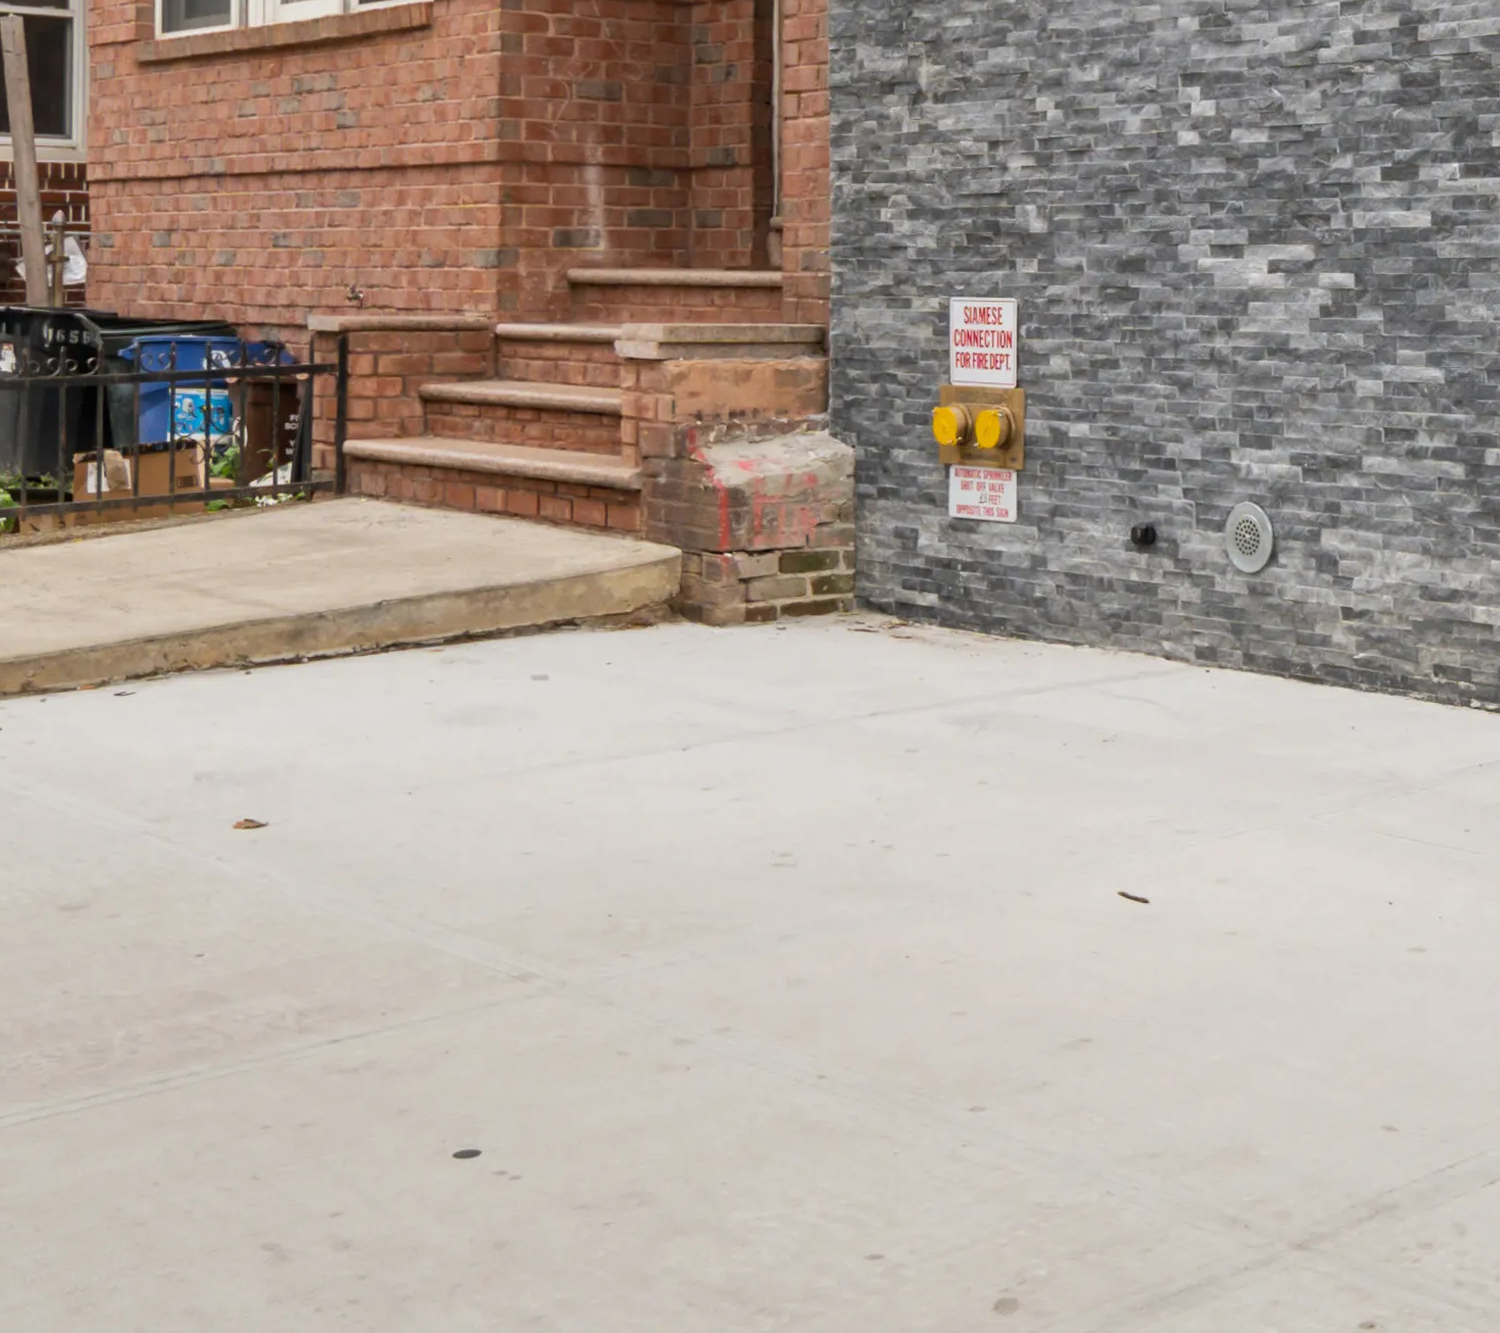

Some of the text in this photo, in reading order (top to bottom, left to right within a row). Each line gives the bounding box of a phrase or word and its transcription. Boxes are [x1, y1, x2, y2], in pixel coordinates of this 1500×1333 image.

[963, 306, 1003, 325] SIAMESE
[954, 329, 1013, 348] CONNECTION
[955, 352, 1012, 370] FOR FIRE DEPT.
